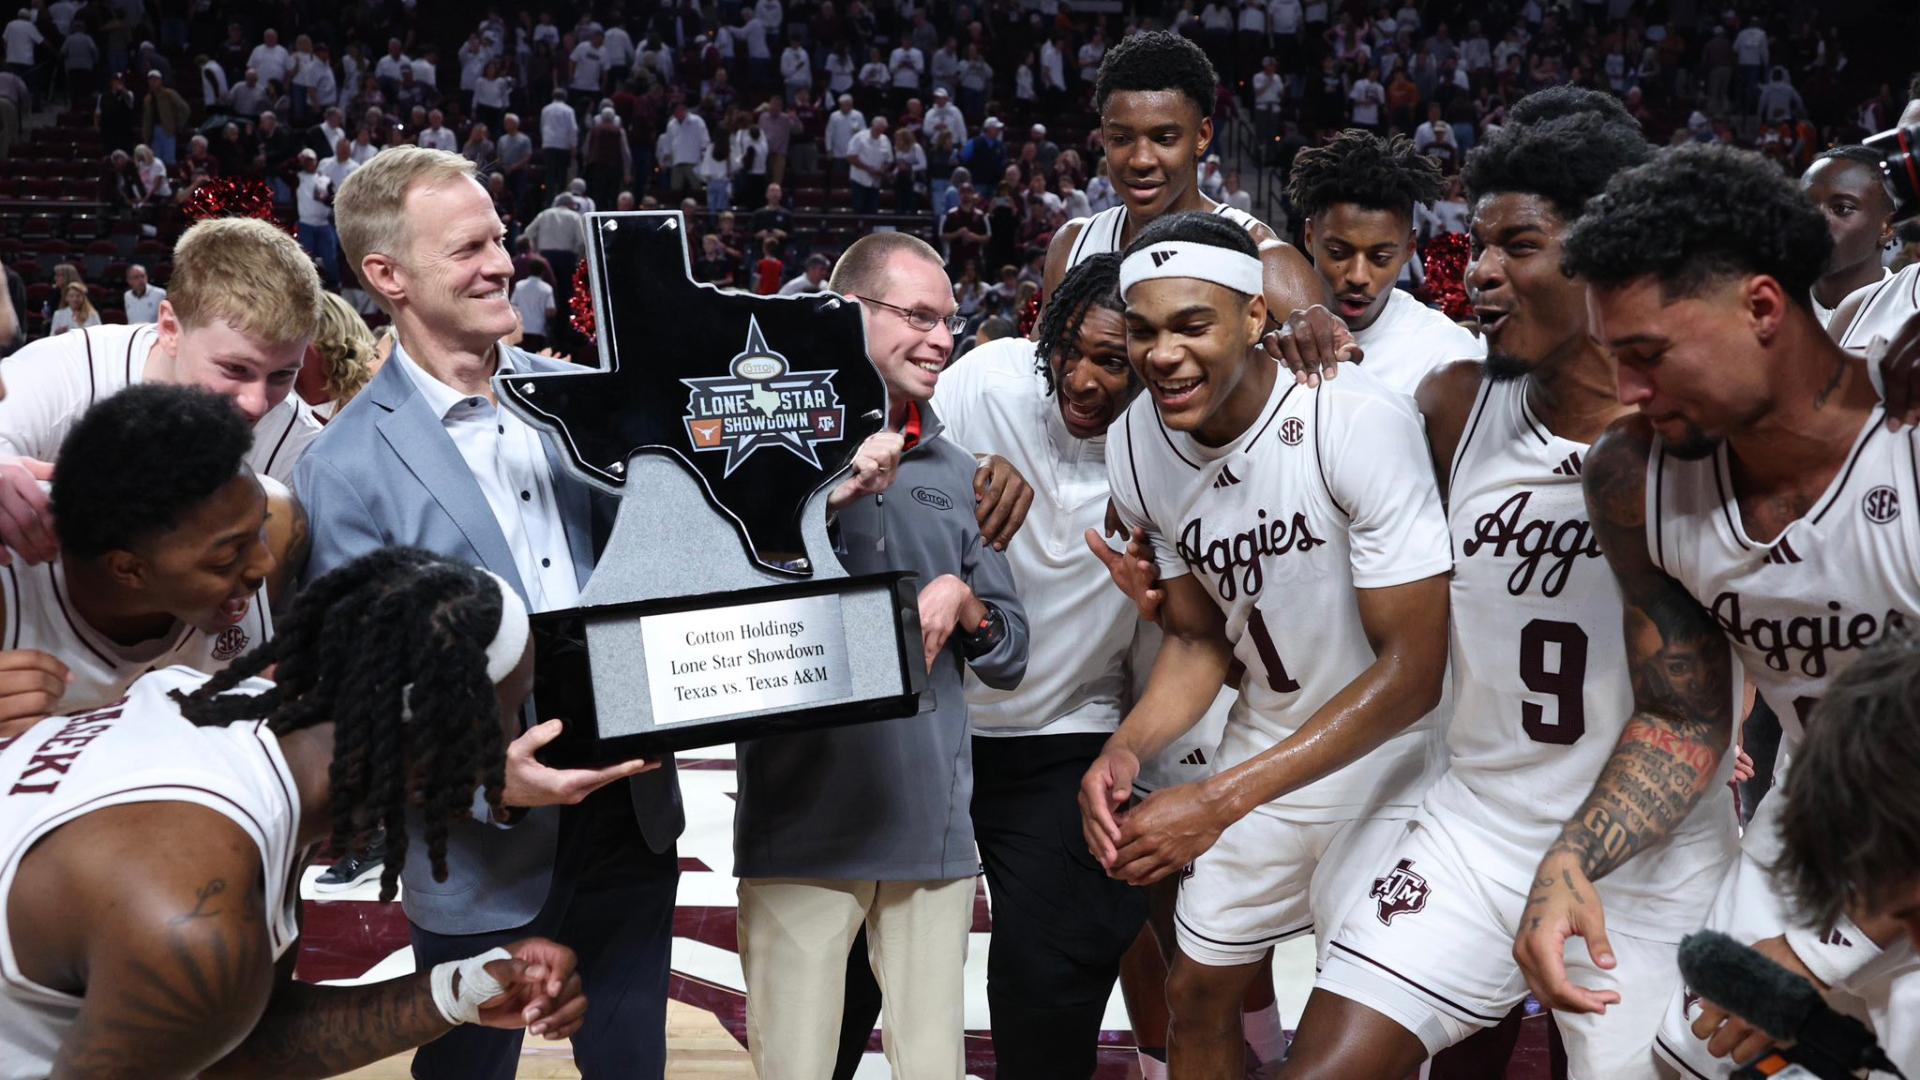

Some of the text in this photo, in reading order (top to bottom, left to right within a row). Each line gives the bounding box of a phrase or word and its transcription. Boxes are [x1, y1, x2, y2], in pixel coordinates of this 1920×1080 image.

[700, 389, 826, 416] LONE STAR
[724, 412, 809, 433] SHOWDOWN
[1282, 420, 1304, 442] SEC
[1866, 489, 1898, 520] SEC
[1175, 508, 1327, 601] Aggies
[1463, 491, 1604, 598] Agg
[218, 628, 243, 651] SEC
[685, 620, 805, 647] Cotton Holdings
[1248, 604, 1301, 693] 1
[671, 643, 825, 676] Lone Star Showdown
[674, 666, 828, 701] Texas vs. Texas A&M
[1520, 618, 1588, 746] 9
[7, 695, 130, 796] ASEKI
